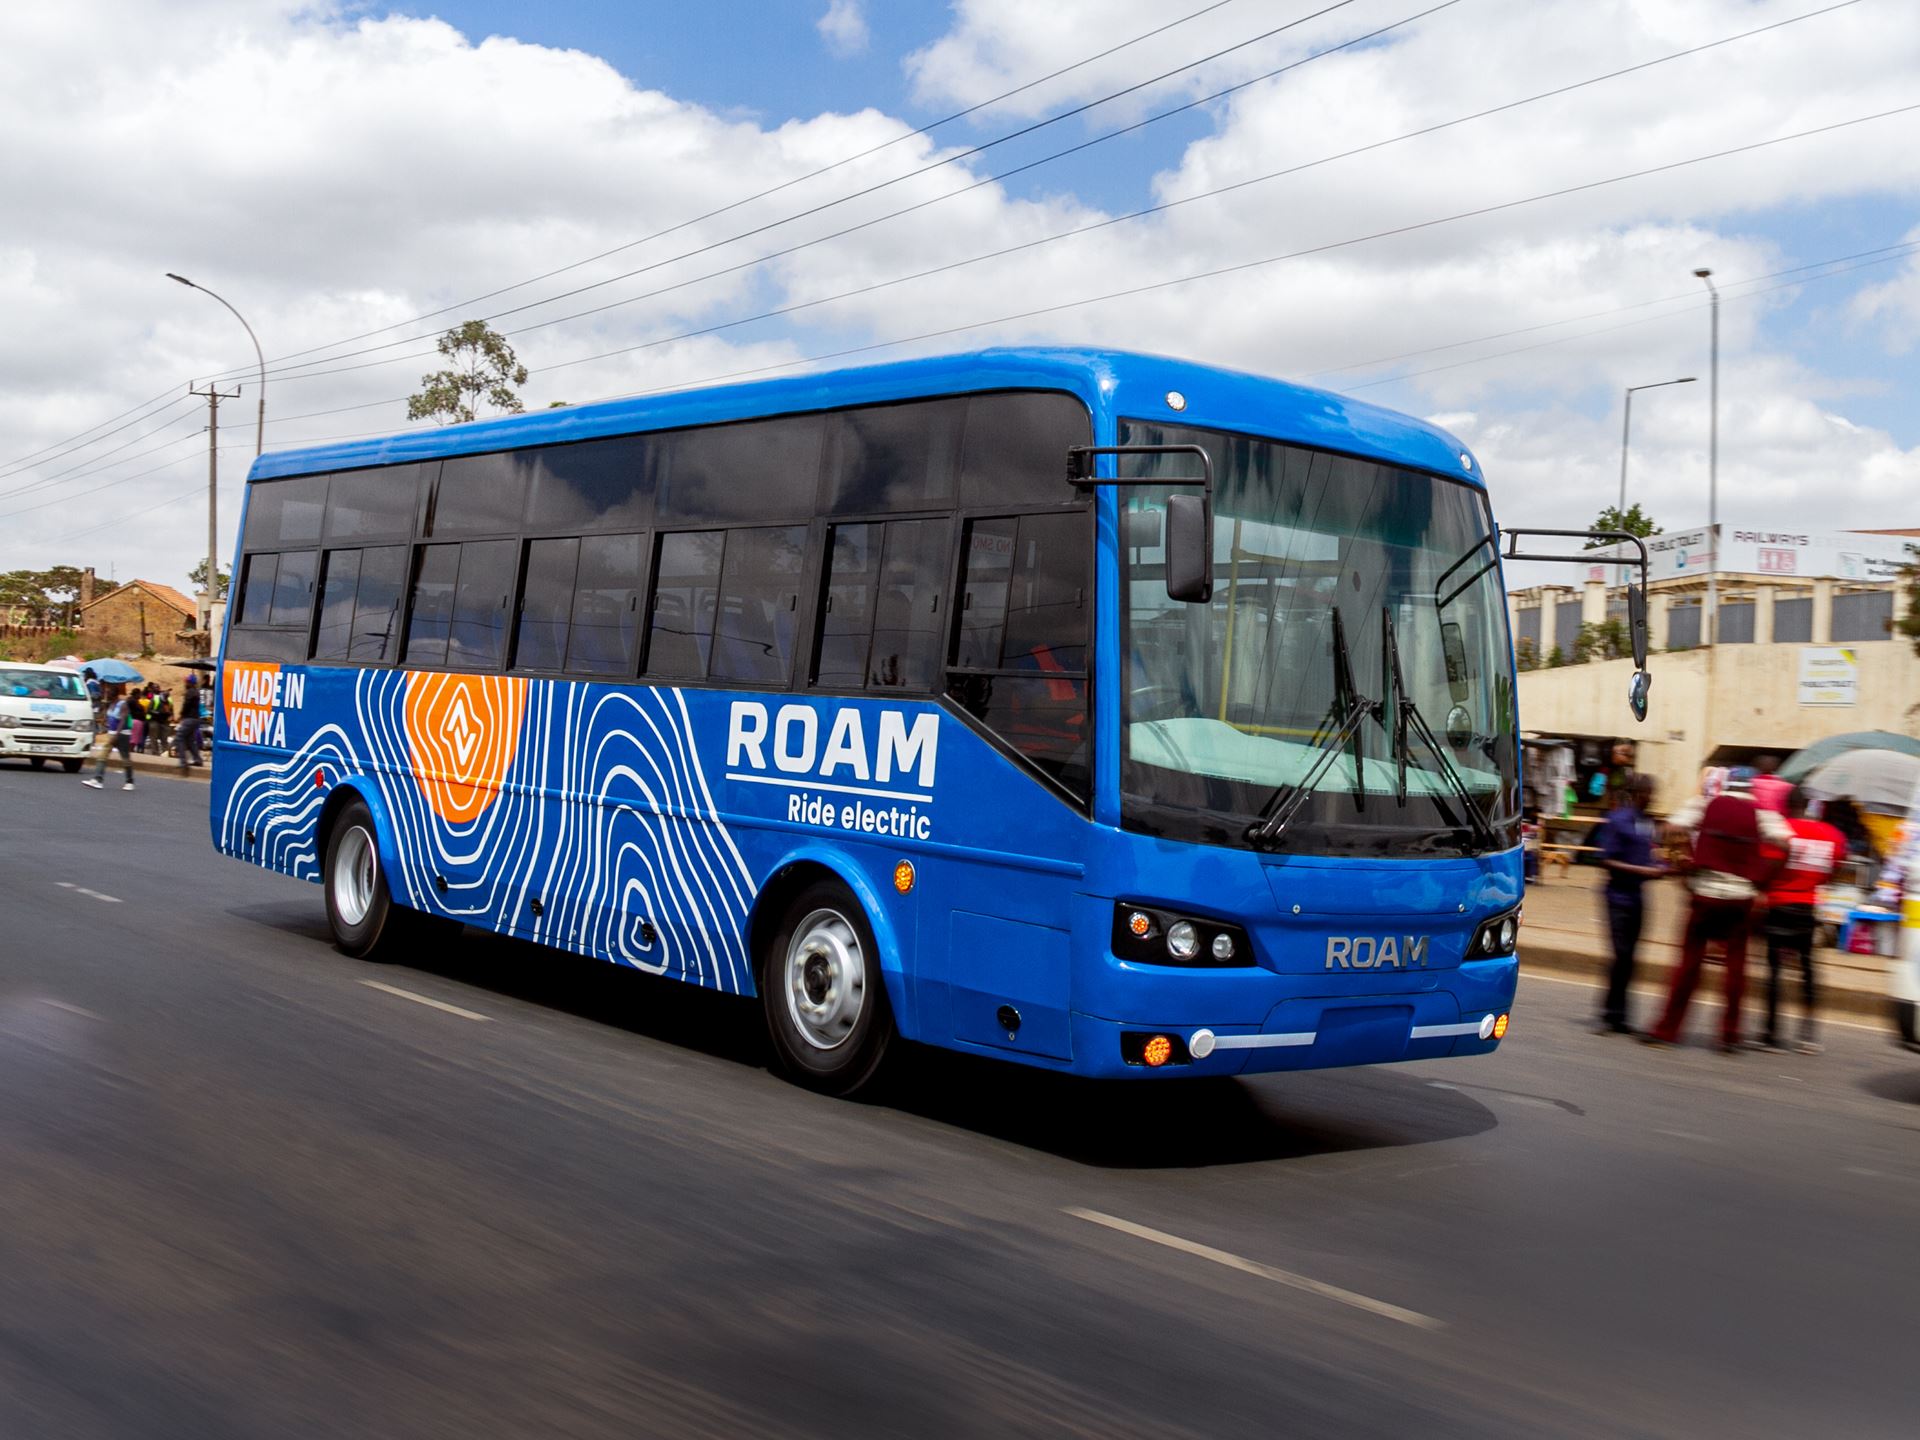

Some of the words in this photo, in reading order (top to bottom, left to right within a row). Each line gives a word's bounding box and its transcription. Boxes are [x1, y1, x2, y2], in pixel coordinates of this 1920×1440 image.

[1733, 530, 1809, 546] RAILWAYS
[232, 669, 284, 707] MADE
[284, 672, 306, 710] IN
[229, 706, 287, 749] KENYA
[726, 700, 940, 788] ROAM
[787, 792, 836, 827] Ride
[841, 800, 932, 840] electric
[1325, 935, 1431, 969] ROAM
